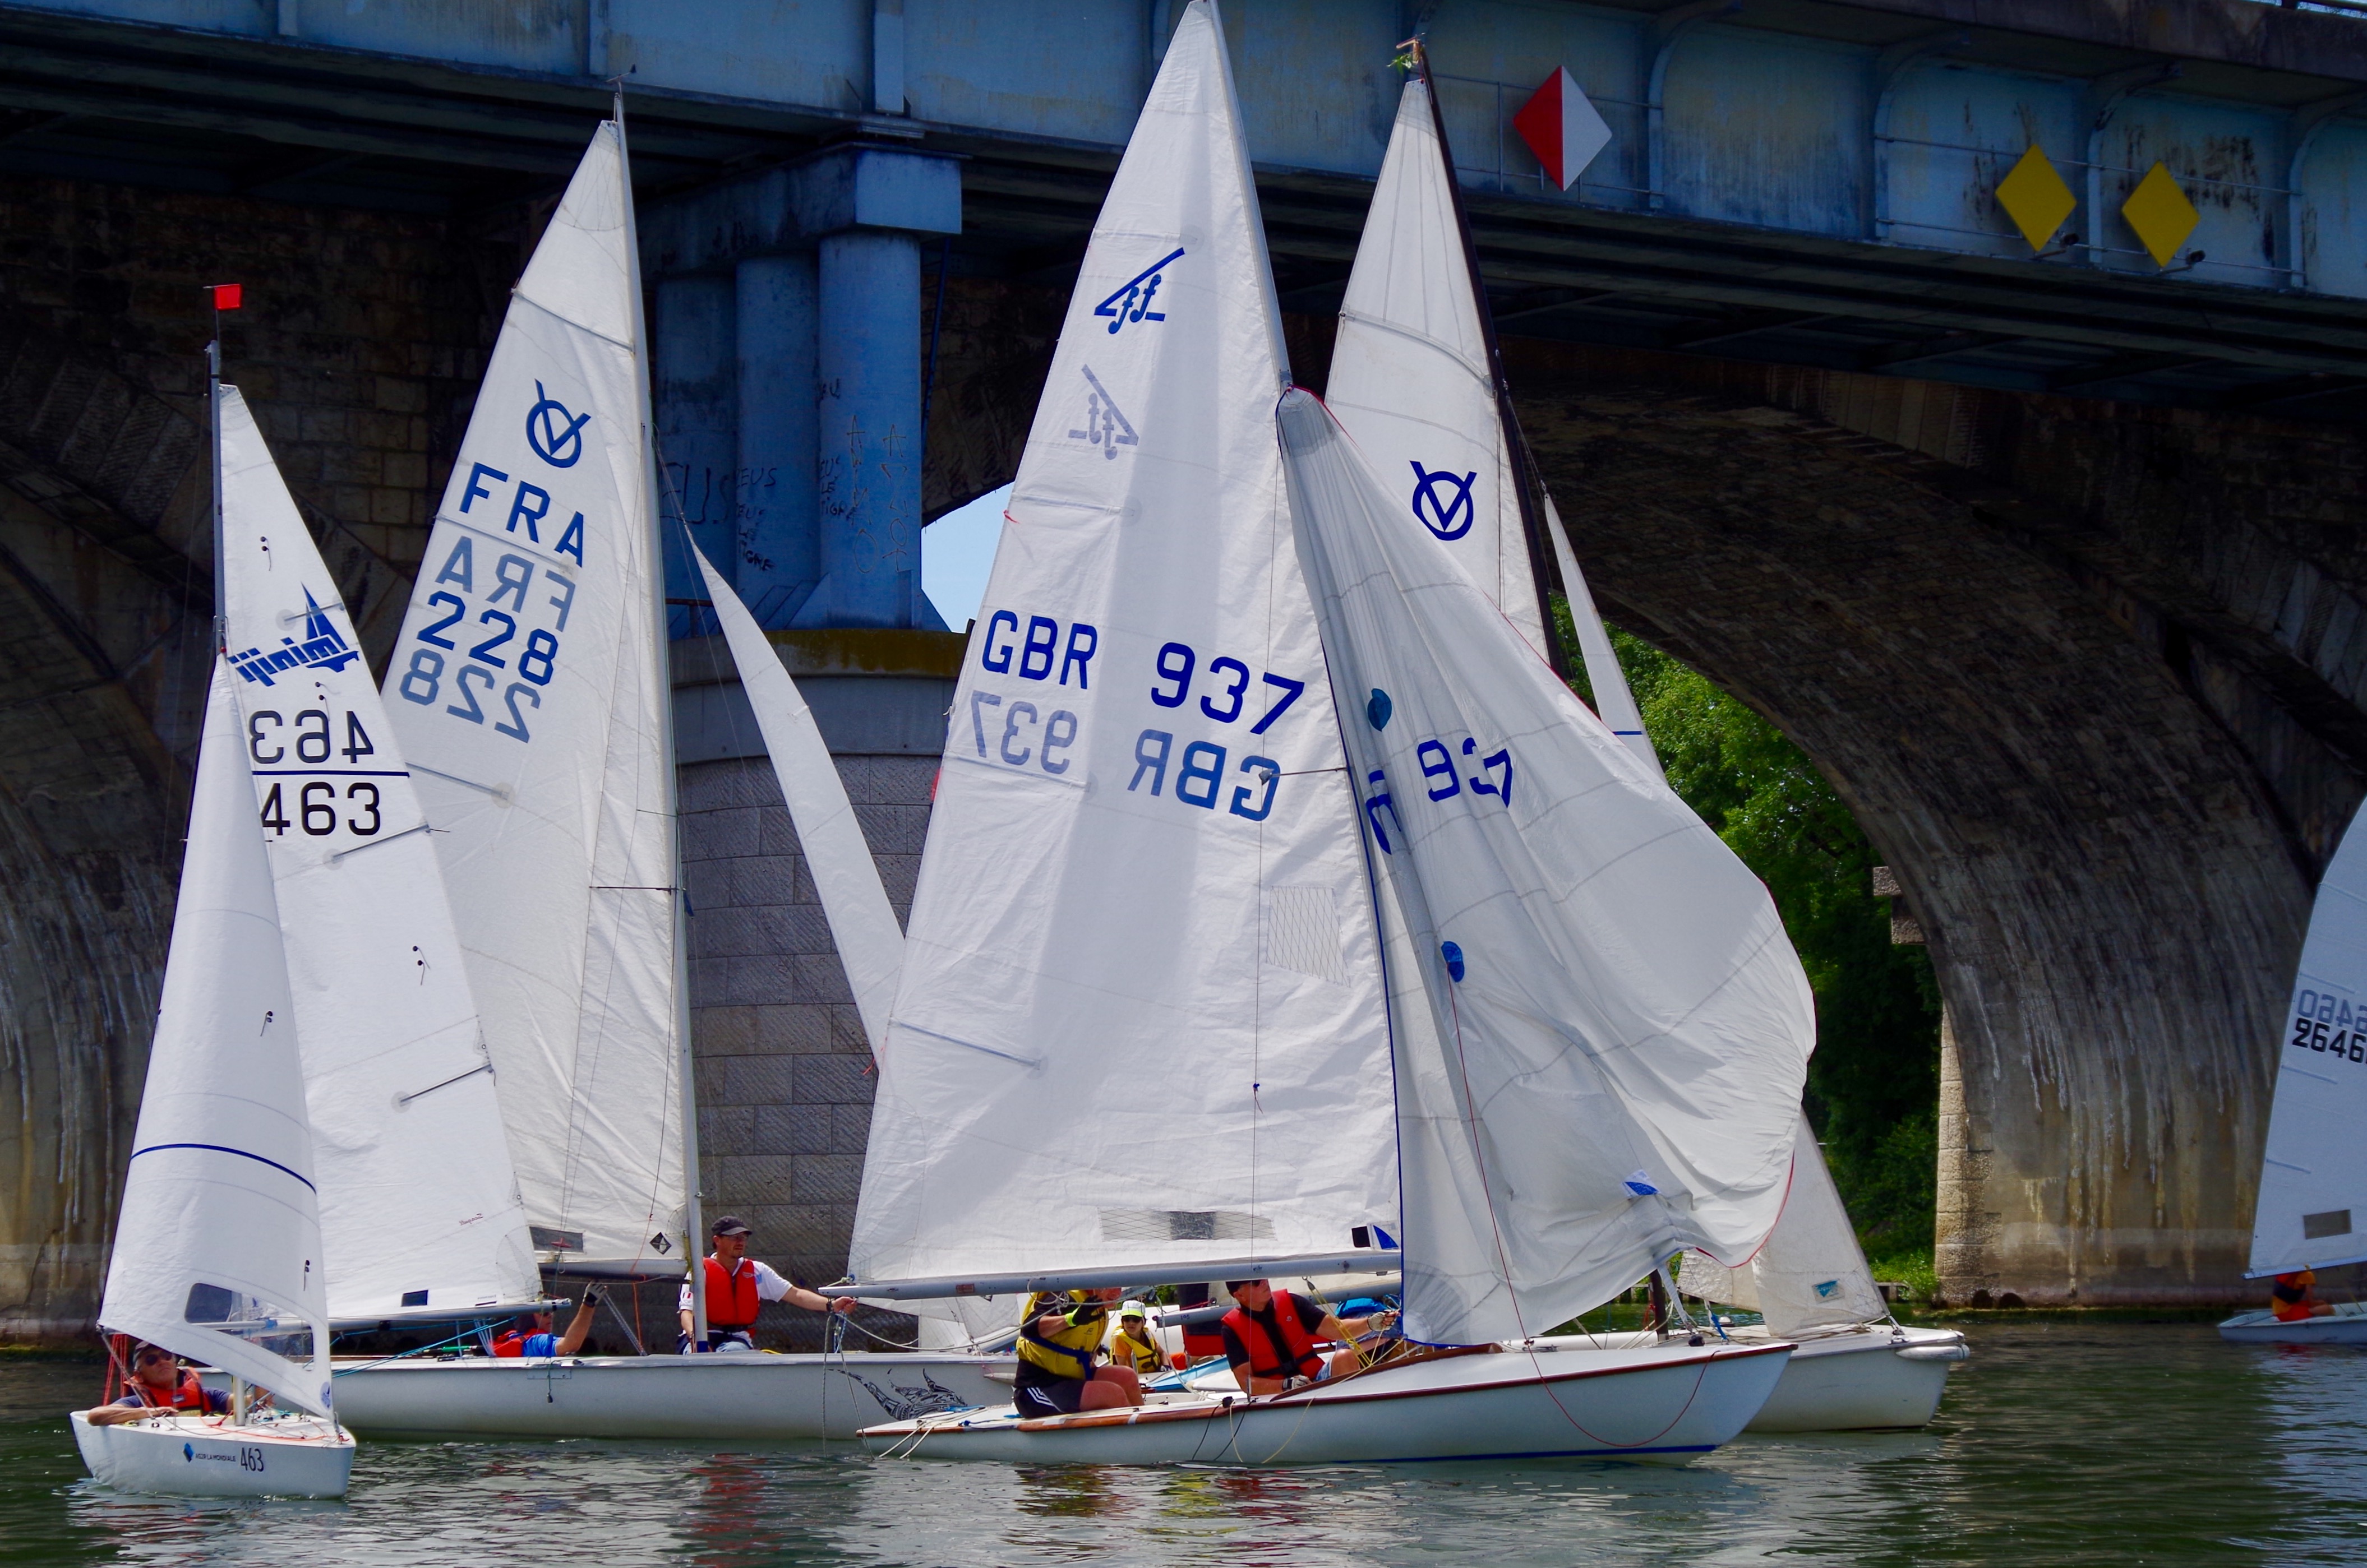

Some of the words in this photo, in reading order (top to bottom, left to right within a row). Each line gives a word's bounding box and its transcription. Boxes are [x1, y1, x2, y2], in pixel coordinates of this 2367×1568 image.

[459, 462, 584, 567] FRA
[416, 591, 558, 686] 228
[982, 609, 1097, 690] GBR
[1151, 642, 1305, 734] 937
[262, 782, 381, 836] 463
[2292, 1017, 2367, 1065] 2646
[241, 1447, 264, 1472] 463
